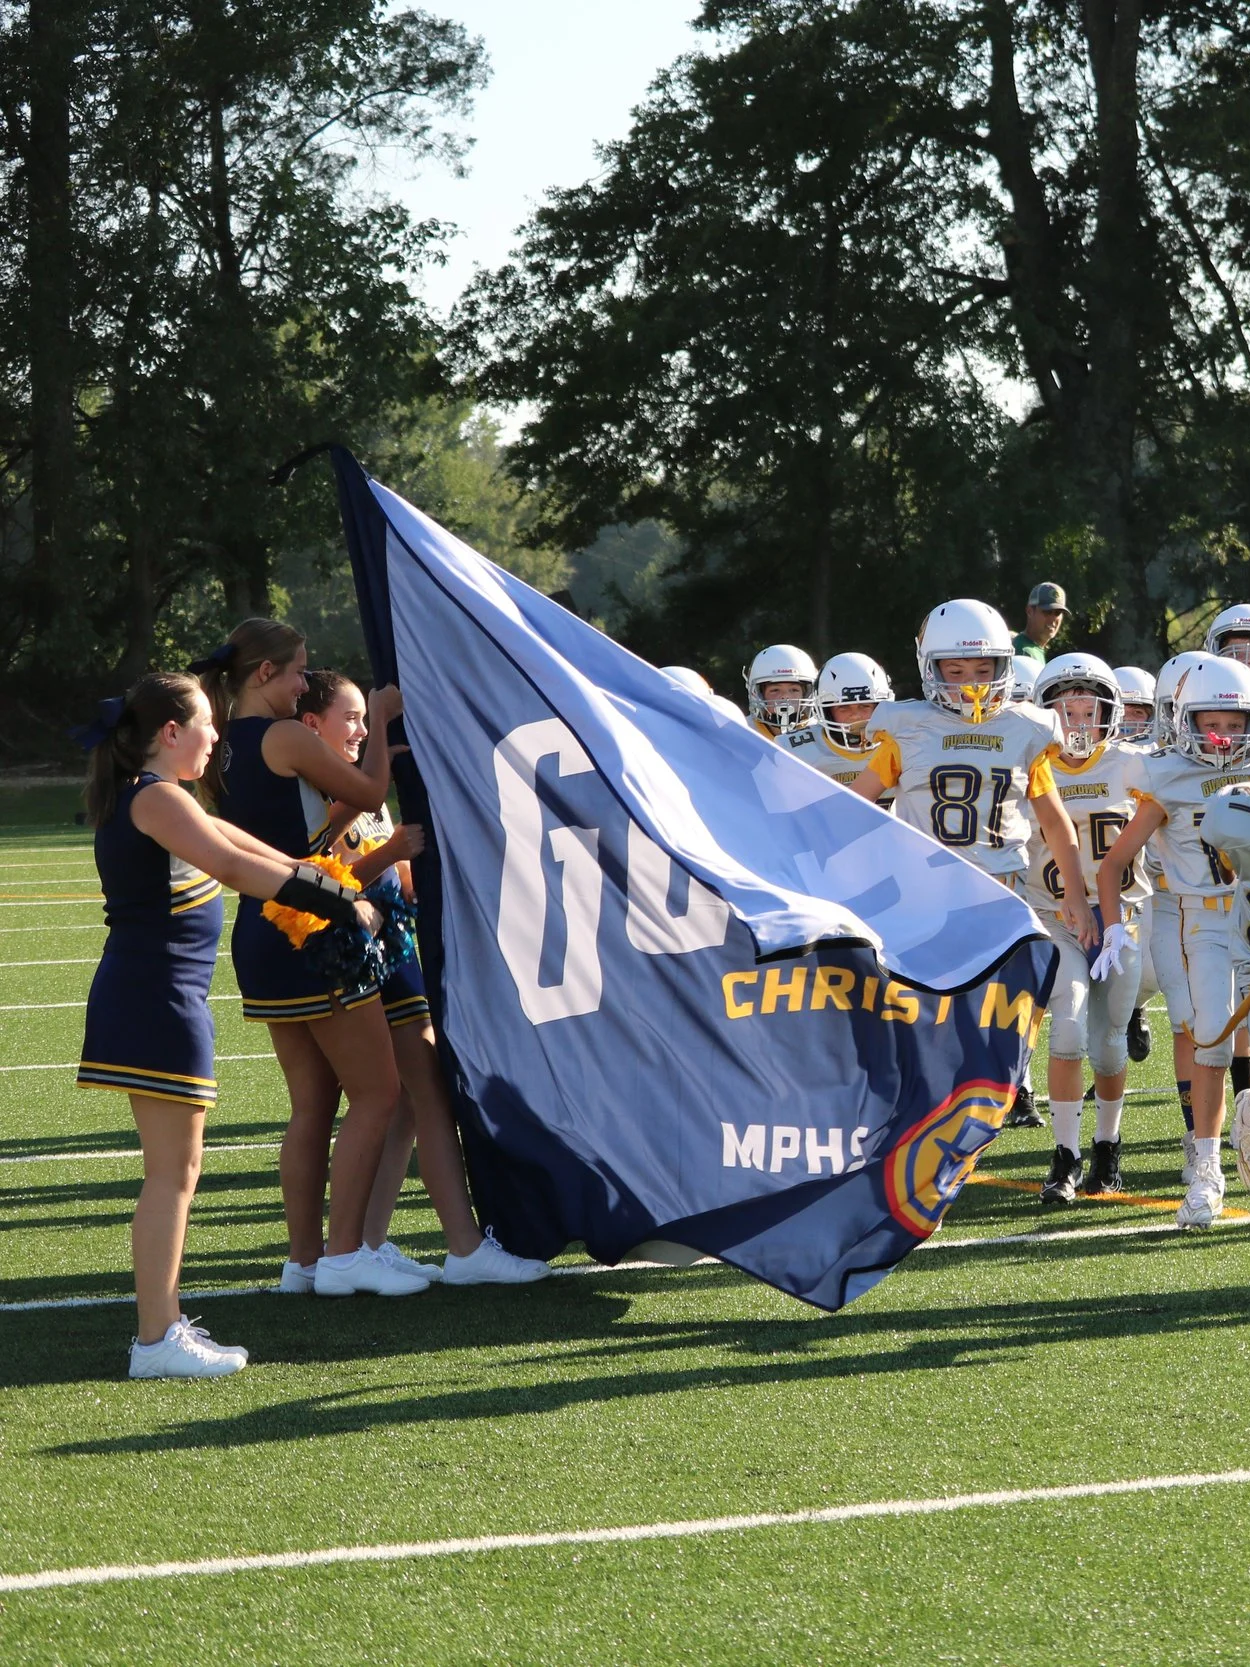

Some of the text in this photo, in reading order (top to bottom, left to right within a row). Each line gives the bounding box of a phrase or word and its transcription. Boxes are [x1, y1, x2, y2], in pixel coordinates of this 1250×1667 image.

[787, 727, 815, 748] 3
[942, 733, 1004, 752] GUARDIANS
[930, 764, 1012, 849] 81
[721, 1121, 869, 1175] MPHS
